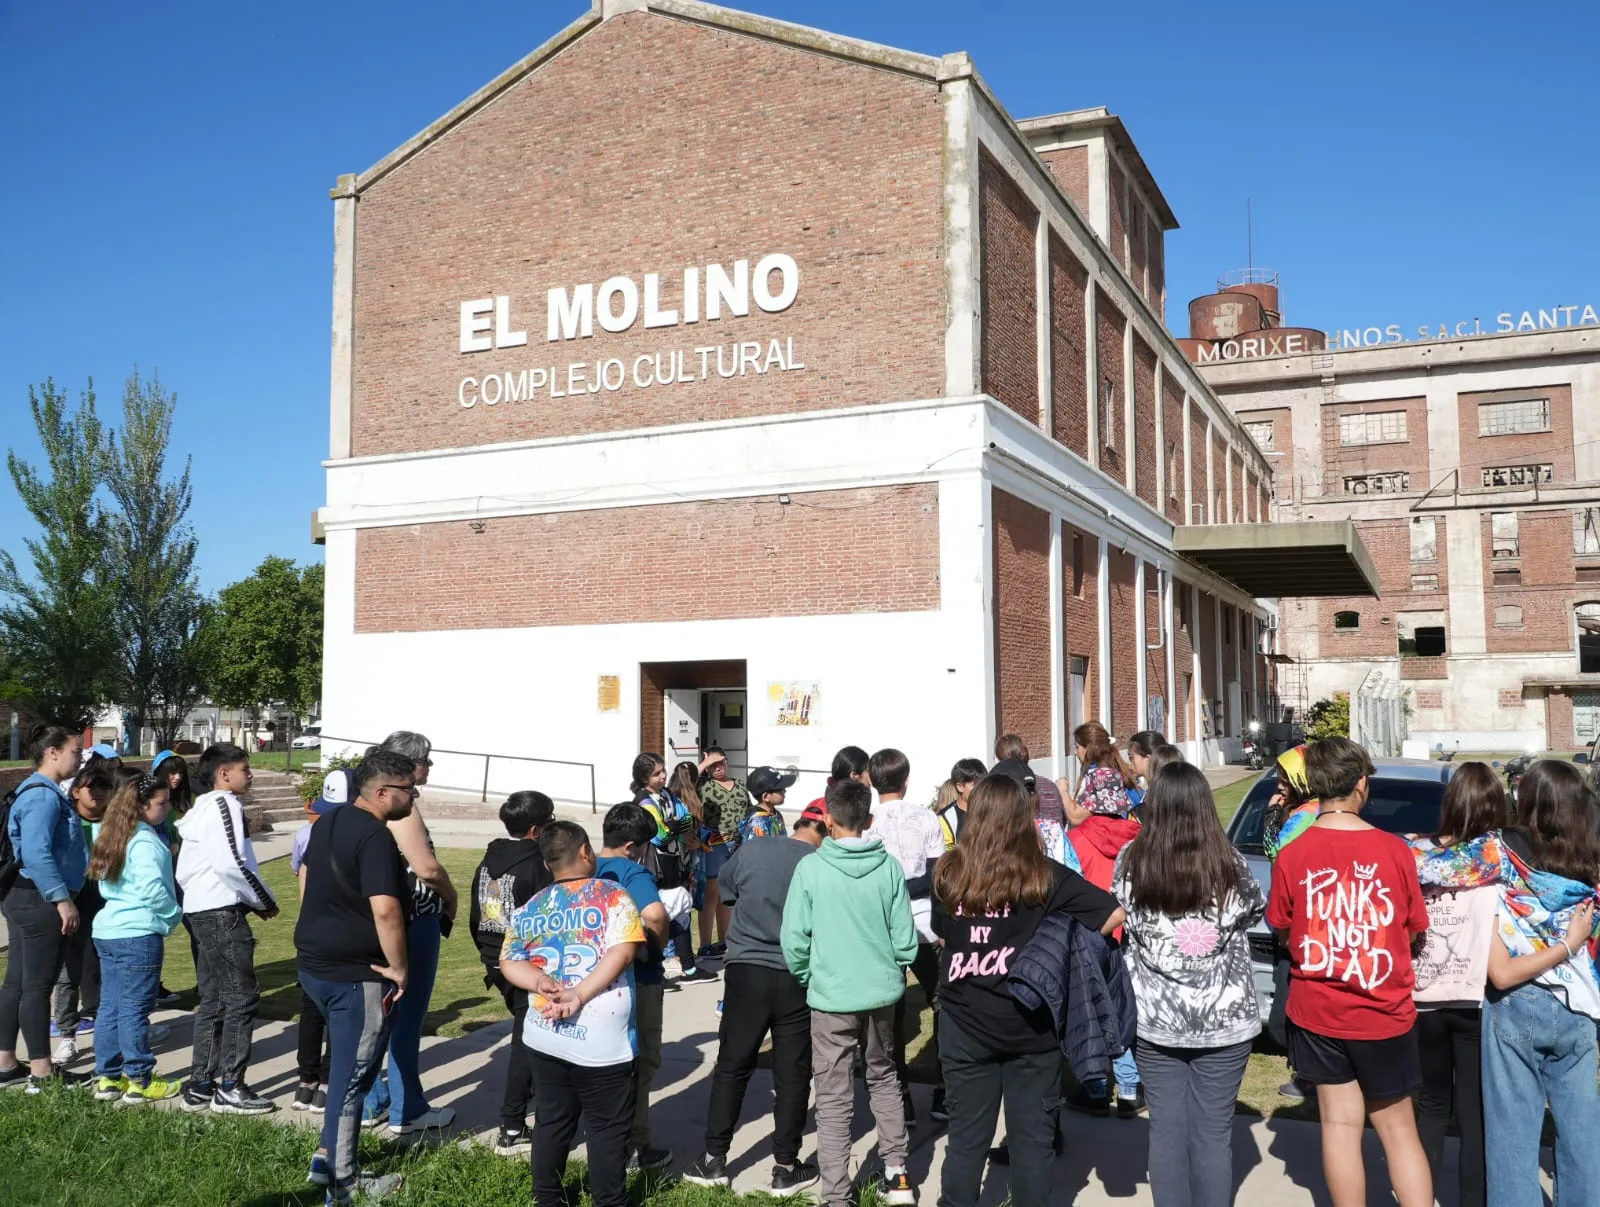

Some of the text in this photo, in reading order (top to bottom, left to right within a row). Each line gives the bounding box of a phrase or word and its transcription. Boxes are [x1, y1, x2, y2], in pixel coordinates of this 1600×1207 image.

[459, 253, 799, 353] EL MOLINO
[1197, 334, 1302, 362] MORIXE
[1496, 304, 1600, 333] SANTA
[458, 336, 804, 408] COMPLEJO CULTURAL
[520, 906, 602, 939] PROMO
[969, 925, 992, 944] MY
[948, 946, 1016, 982] BACK
